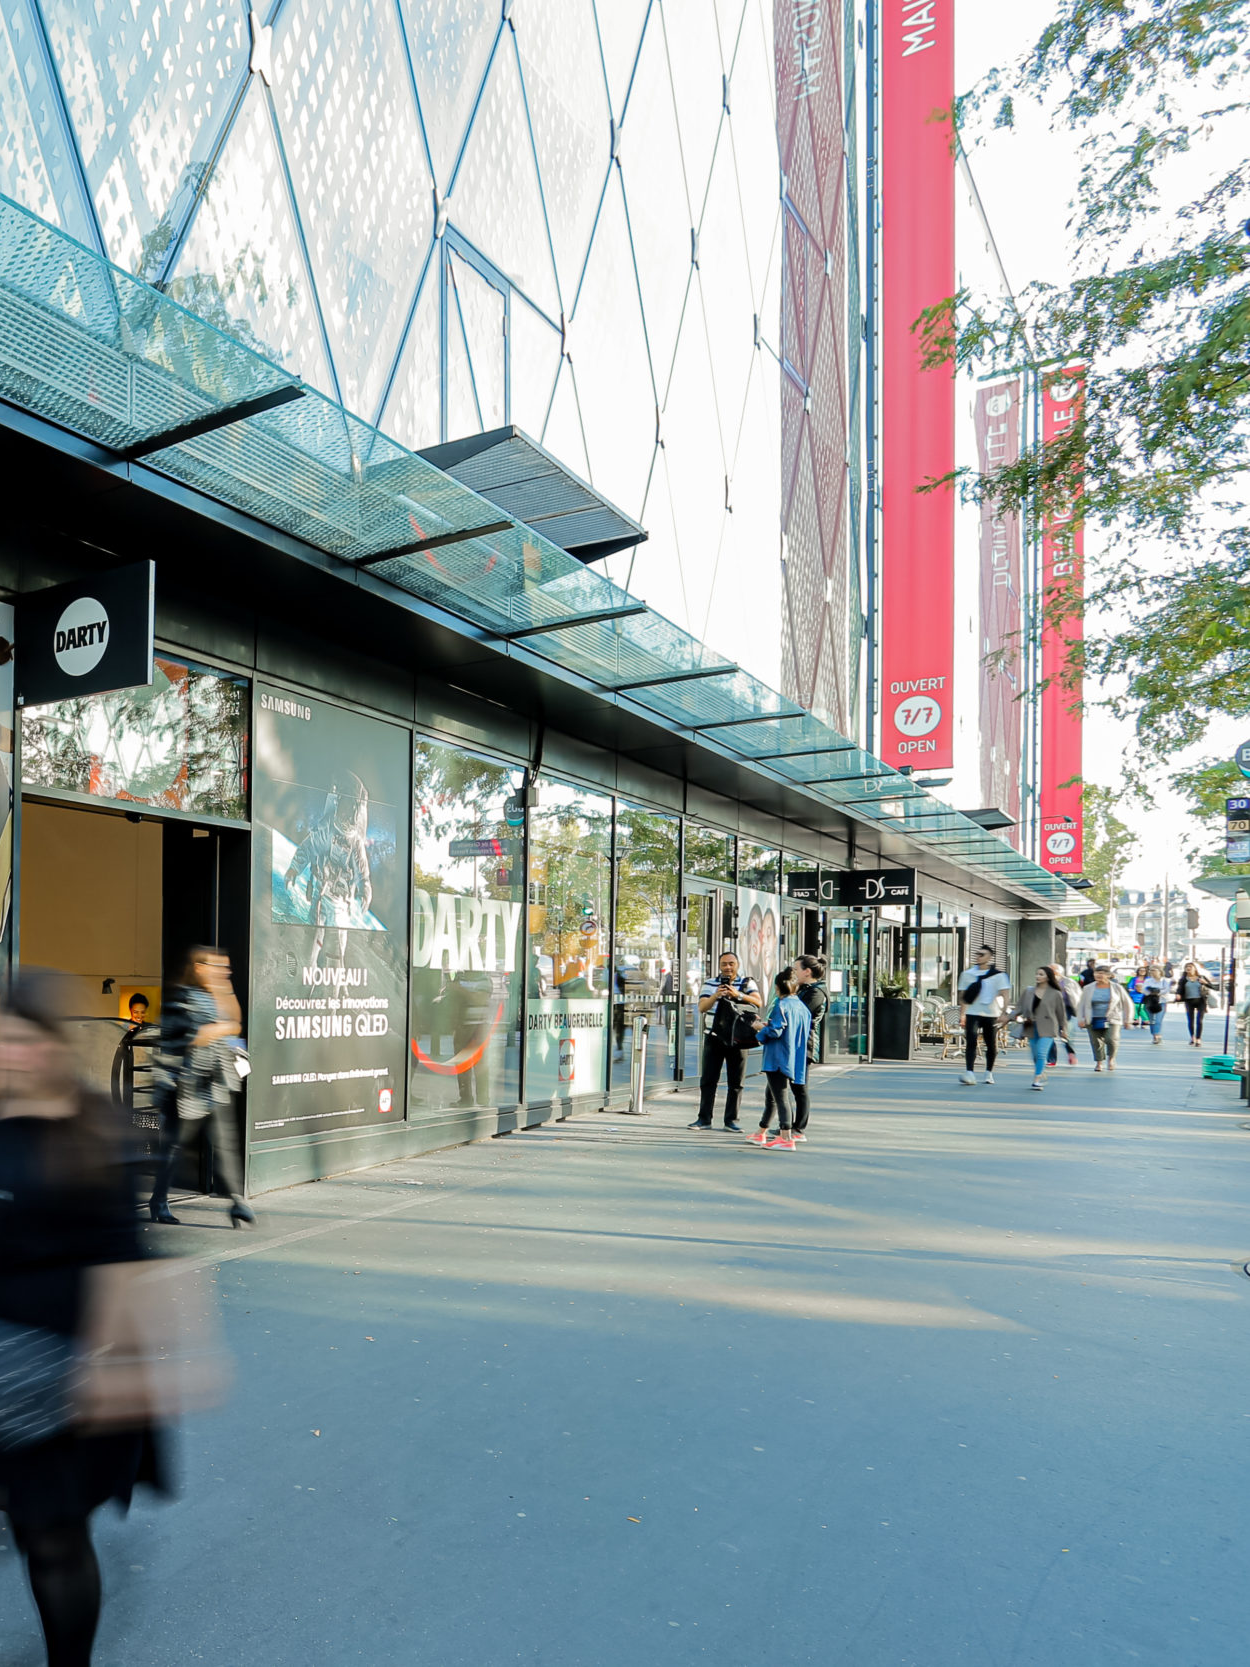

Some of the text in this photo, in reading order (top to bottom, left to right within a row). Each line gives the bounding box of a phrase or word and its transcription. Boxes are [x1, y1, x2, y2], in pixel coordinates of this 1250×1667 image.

[56, 621, 108, 653] DARTY
[890, 676, 946, 694] OUVERT
[261, 693, 311, 721] SAMSUNG
[901, 706, 933, 725] 7/7
[898, 739, 937, 755] OPEN
[1229, 799, 1248, 809] 30
[1044, 822, 1078, 831] OUVERT
[1230, 821, 1247, 830] 70
[1051, 838, 1070, 849] 7/7
[1048, 856, 1072, 865] OPEN
[866, 876, 886, 899] DS
[412, 888, 523, 972] DARTY
[303, 967, 361, 986] NOUVEAU
[275, 996, 327, 1010] Découvrez
[328, 997, 341, 1009] les
[275, 1014, 389, 1040] SAMSUNG QLED
[528, 1012, 604, 1030] DARTY BEAUGRENELLE
